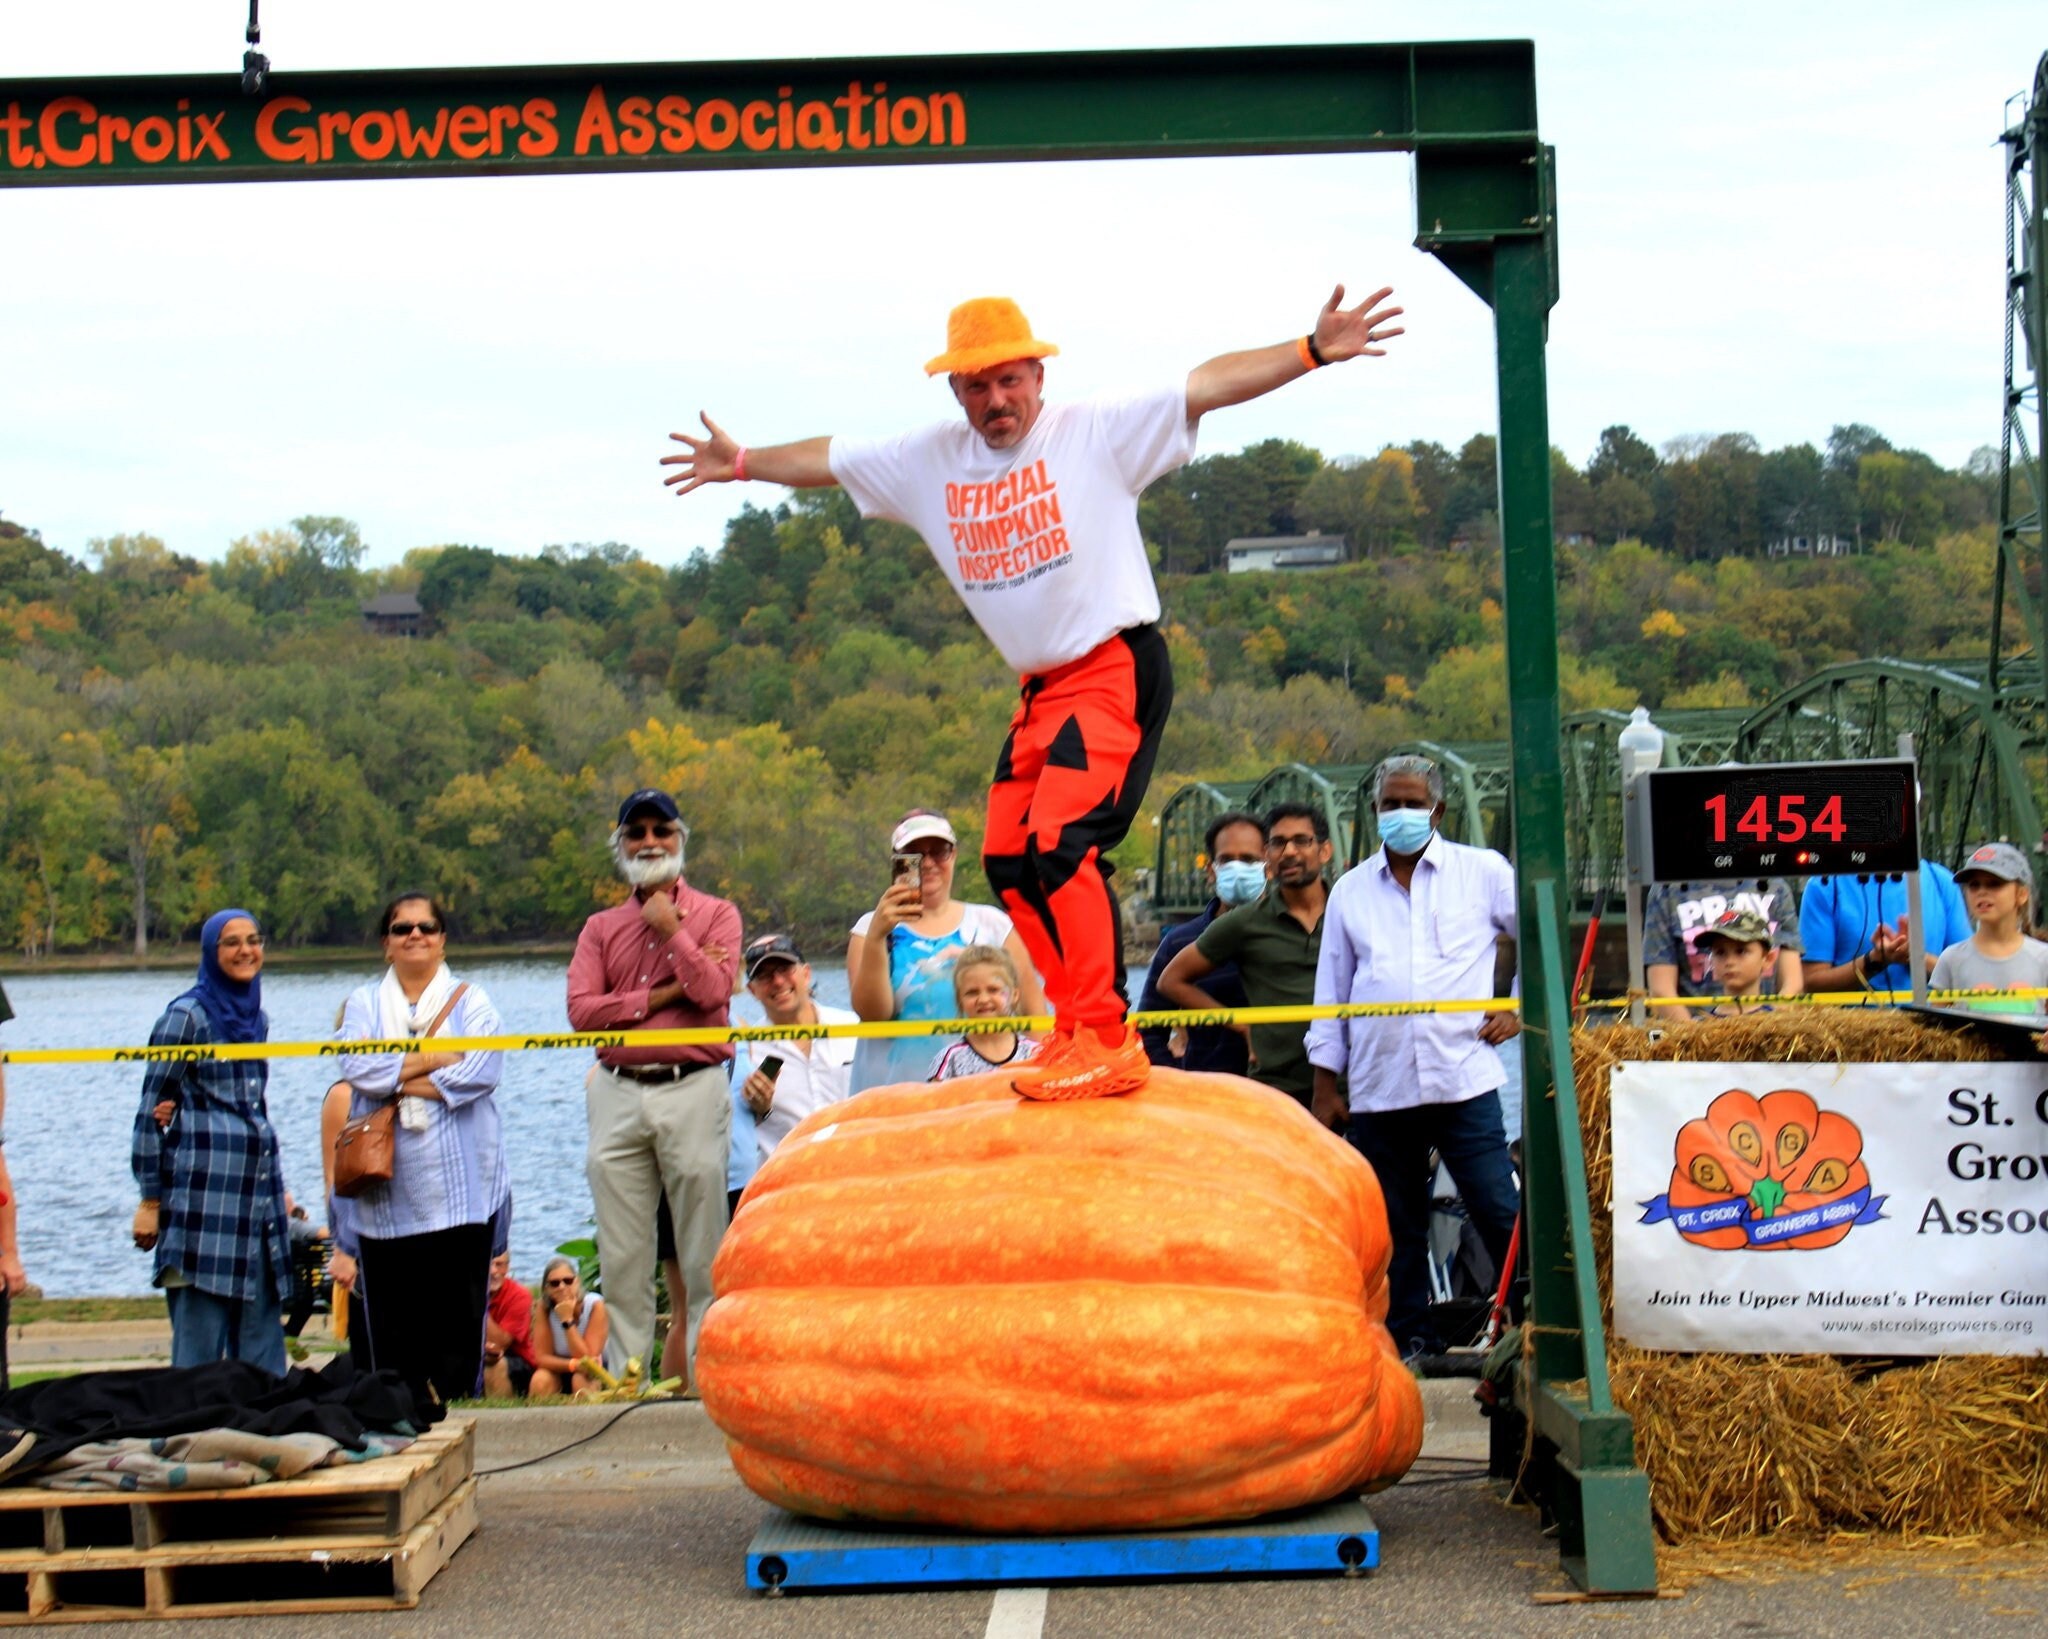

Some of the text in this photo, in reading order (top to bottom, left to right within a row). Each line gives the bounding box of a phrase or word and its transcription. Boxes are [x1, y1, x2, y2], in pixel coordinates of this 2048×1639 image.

[0, 81, 966, 169] t.Croix Growers Association
[945, 458, 1057, 519] OFFICIAL
[948, 492, 1063, 554] PUMPKIN
[957, 527, 1072, 582] INSPECTOR
[1705, 795, 1847, 843] 1454
[1947, 1088, 2014, 1126] St.
[1700, 1206, 1741, 1224] CROIX
[1754, 1212, 1820, 1239] GROWERS
[1647, 1289, 1691, 1307] Join
[1699, 1290, 1731, 1306] the
[1739, 1290, 1800, 1309] Upper
[1806, 1290, 1906, 1307] Midwest's
[1914, 1291, 1994, 1307] Premier
[1822, 1318, 2033, 1335] www.stcroixgrowers.org
